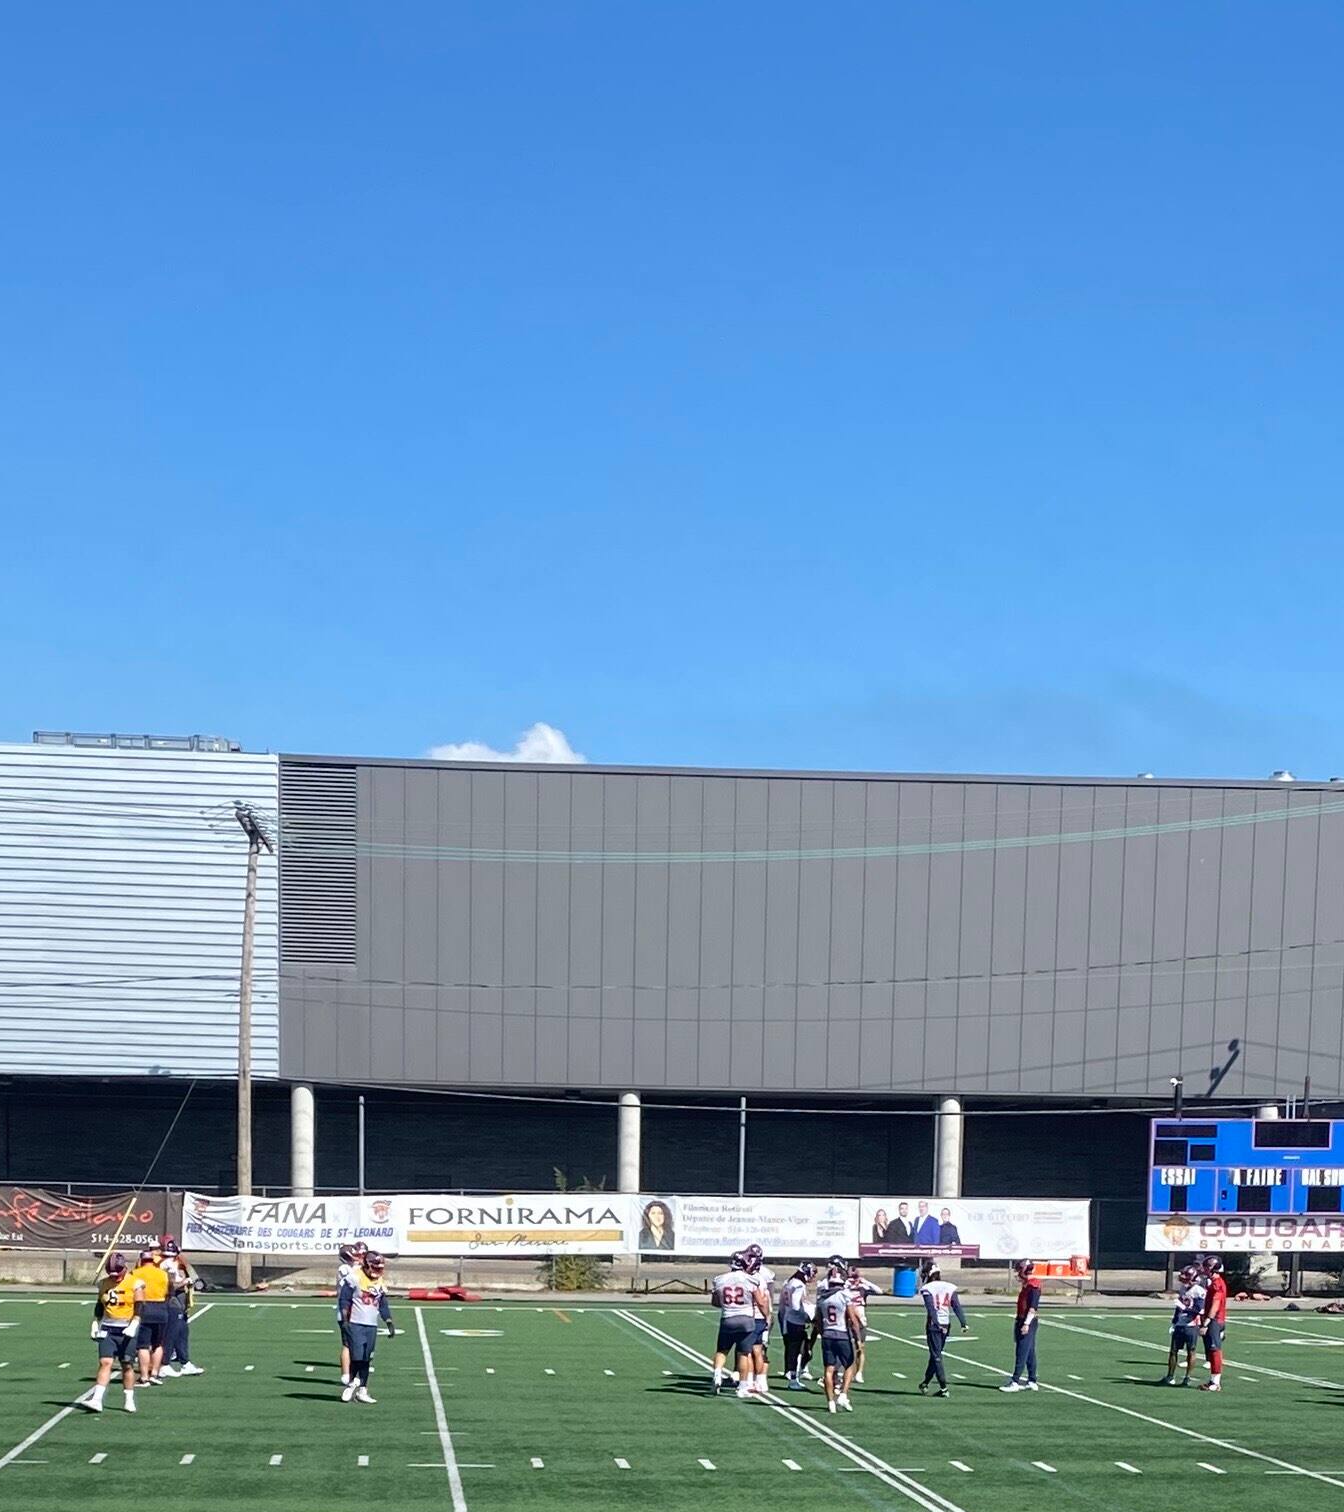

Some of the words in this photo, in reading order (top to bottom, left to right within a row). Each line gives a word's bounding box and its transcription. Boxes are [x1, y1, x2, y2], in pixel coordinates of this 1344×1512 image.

[1161, 1168, 1196, 1185] ESSAI
[1246, 1168, 1282, 1185] FAIRE
[246, 1201, 327, 1224] FANA
[409, 1207, 622, 1225] FORNIRAMA
[257, 1227, 273, 1238] DES
[277, 1227, 316, 1238] COUGARS
[320, 1227, 332, 1238] DE
[233, 1238, 346, 1251] fanasports.com
[722, 1286, 745, 1305] 62
